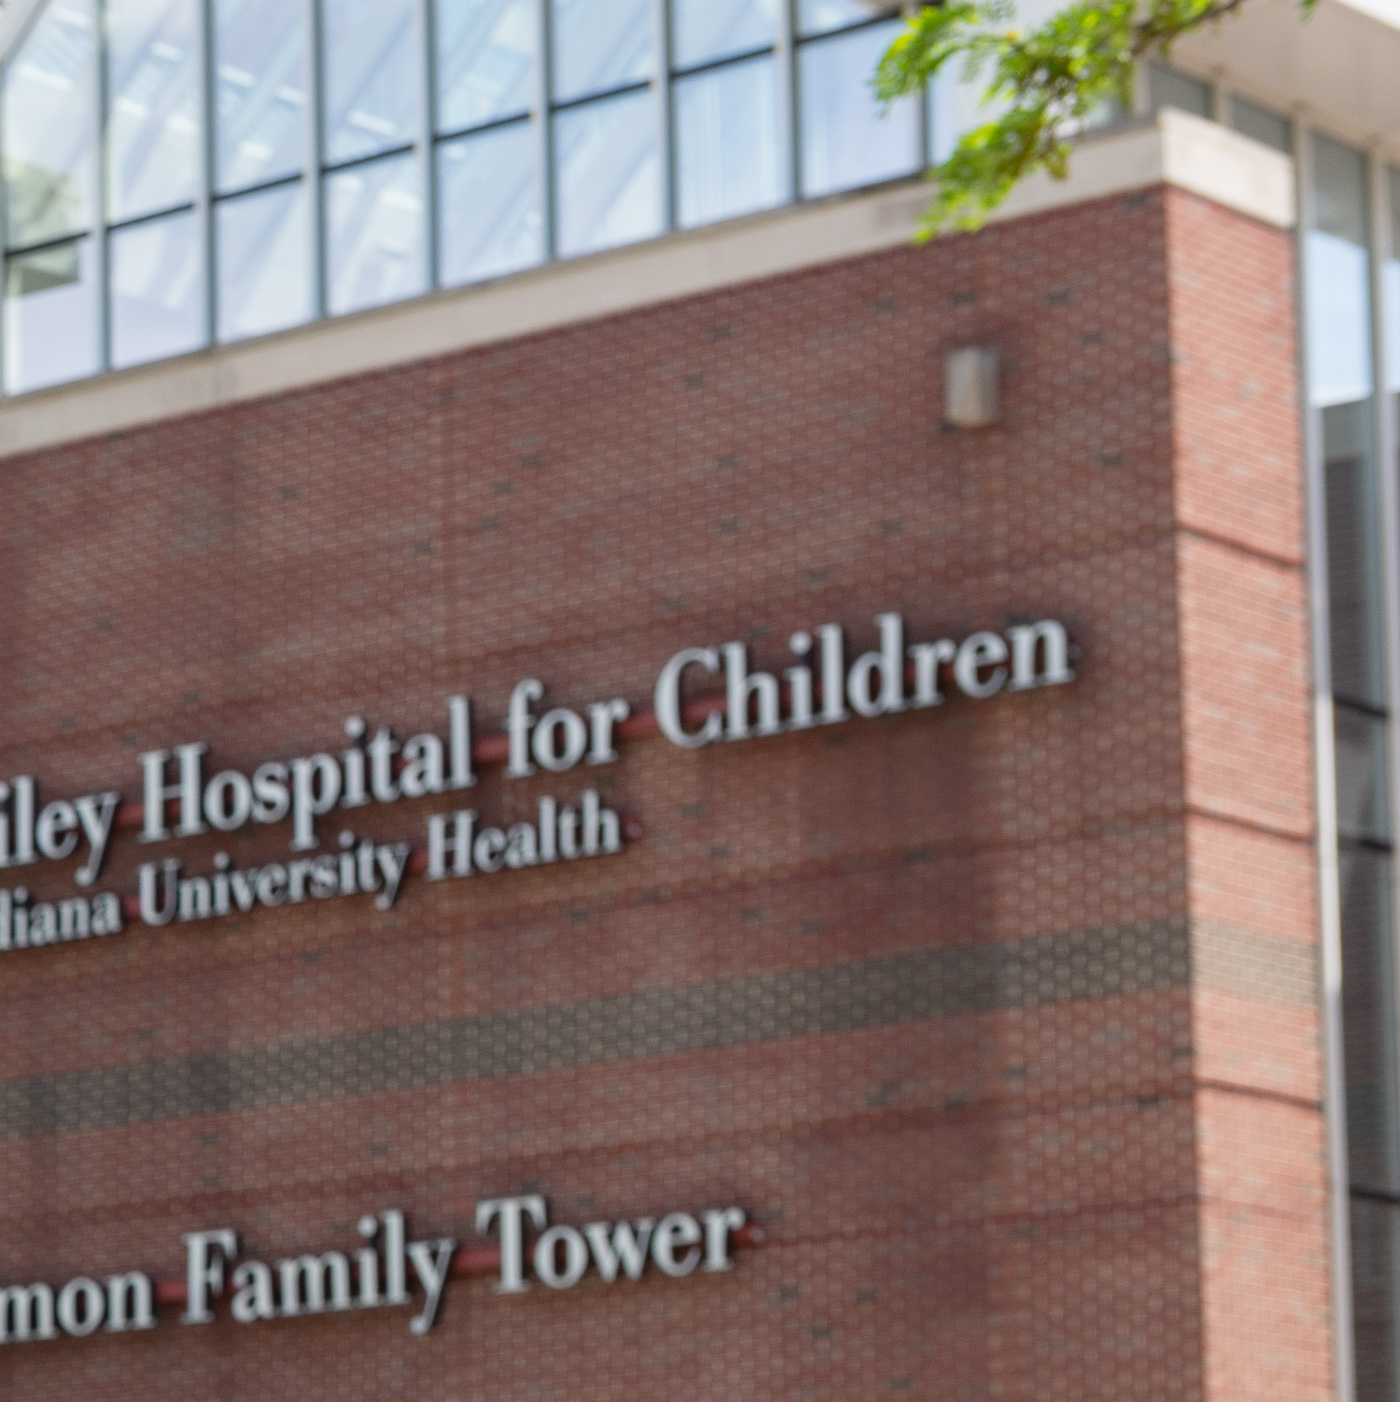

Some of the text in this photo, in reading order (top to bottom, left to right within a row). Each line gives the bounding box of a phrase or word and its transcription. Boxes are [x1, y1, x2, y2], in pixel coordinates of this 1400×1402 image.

[136, 695, 477, 851] Hospital
[504, 678, 630, 778] for
[655, 611, 1074, 748] Children
[138, 829, 410, 926] University
[426, 790, 624, 882] Health
[179, 1210, 456, 1335] Family
[475, 1195, 746, 1294] Tower
